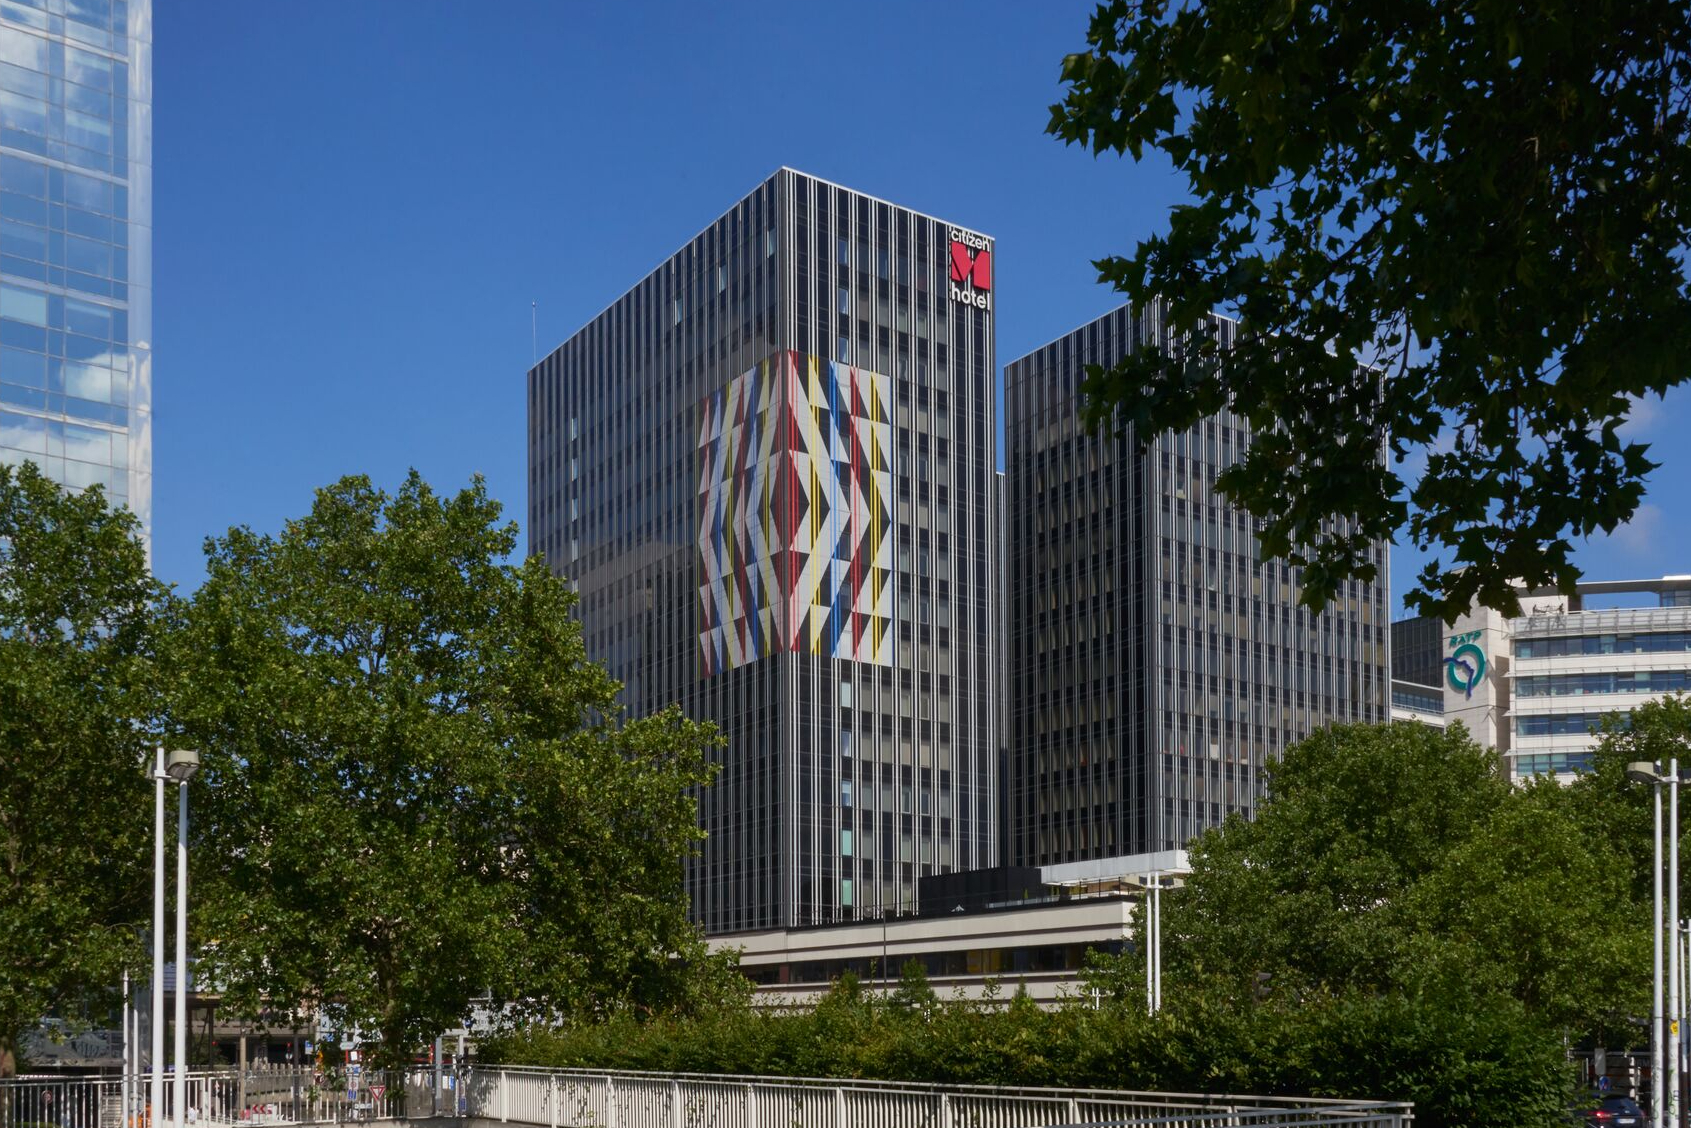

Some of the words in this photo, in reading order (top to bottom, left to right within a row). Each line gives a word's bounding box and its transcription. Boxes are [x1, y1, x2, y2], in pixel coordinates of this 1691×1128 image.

[951, 230, 990, 252] citizen
[951, 241, 990, 290] M
[951, 281, 990, 311] hotel
[1449, 629, 1482, 648] RATP
